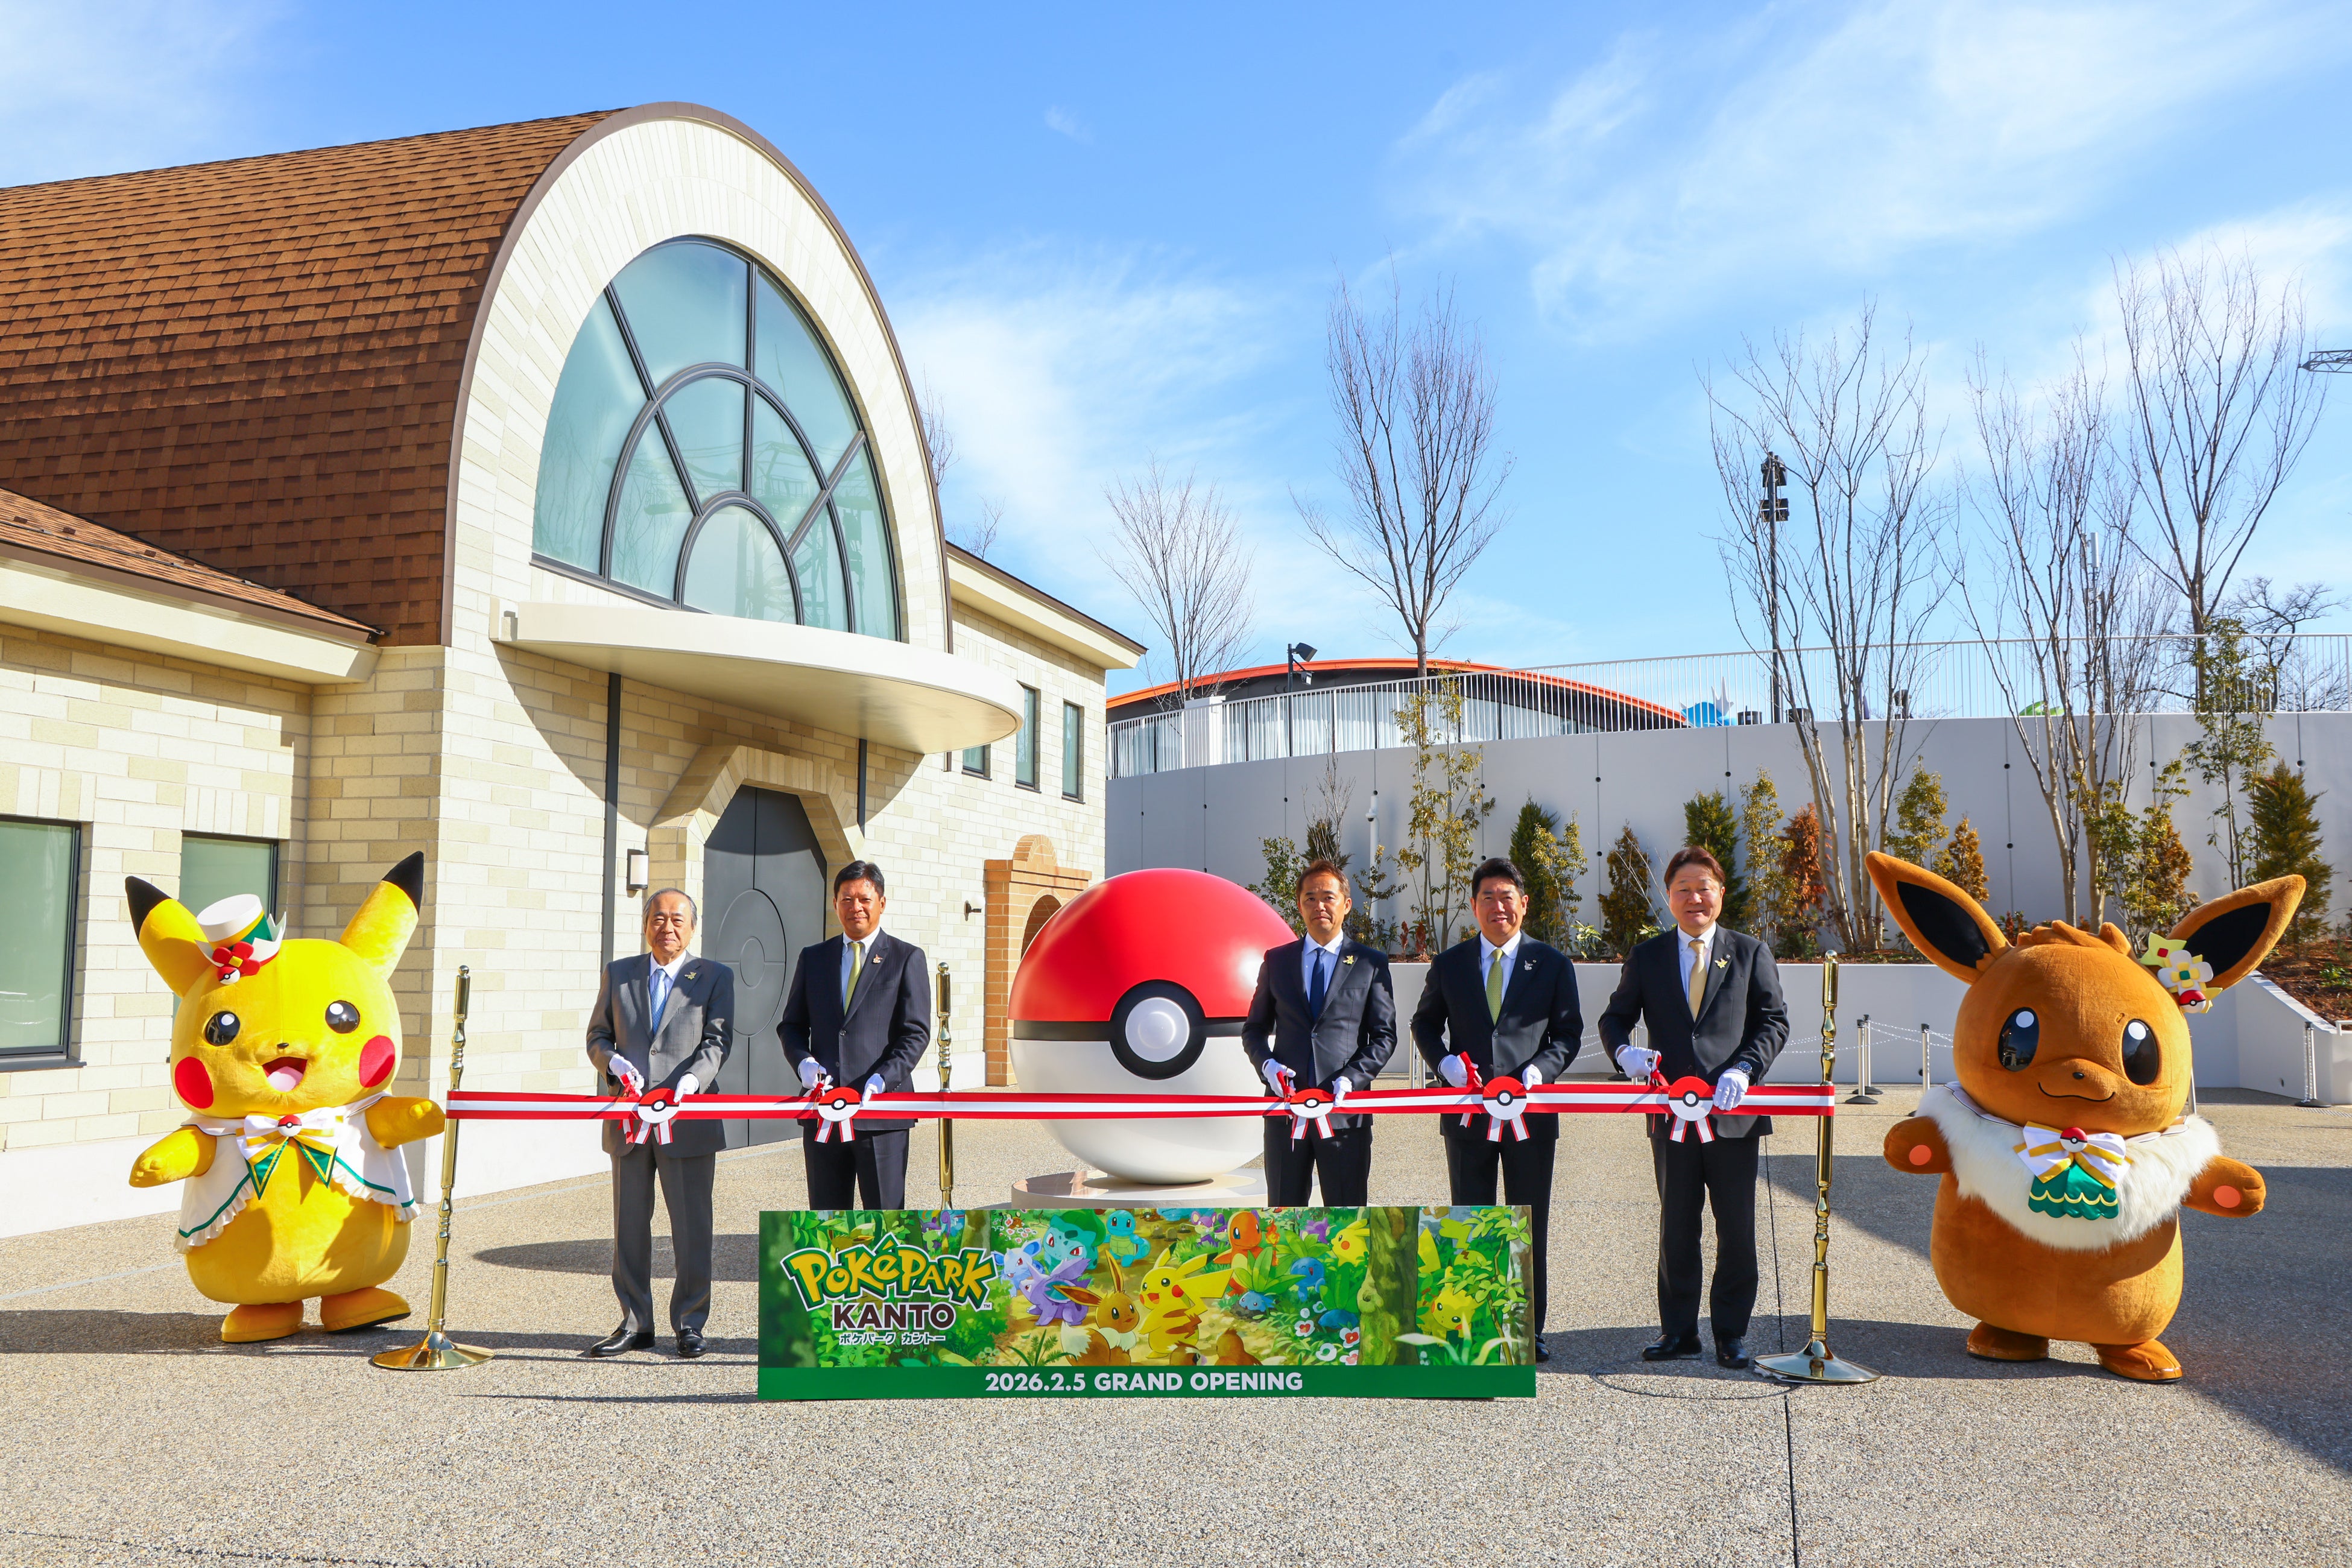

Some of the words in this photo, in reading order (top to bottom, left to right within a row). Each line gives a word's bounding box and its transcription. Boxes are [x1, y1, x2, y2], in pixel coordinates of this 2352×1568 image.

[833, 1303, 955, 1329] KANTO
[839, 1333, 896, 1345] ポケパーク
[902, 1333, 946, 1344] カントー
[985, 1373, 1086, 1391] 2026.2.5
[1093, 1373, 1183, 1391] GRAND
[1190, 1372, 1303, 1391] OPENING
